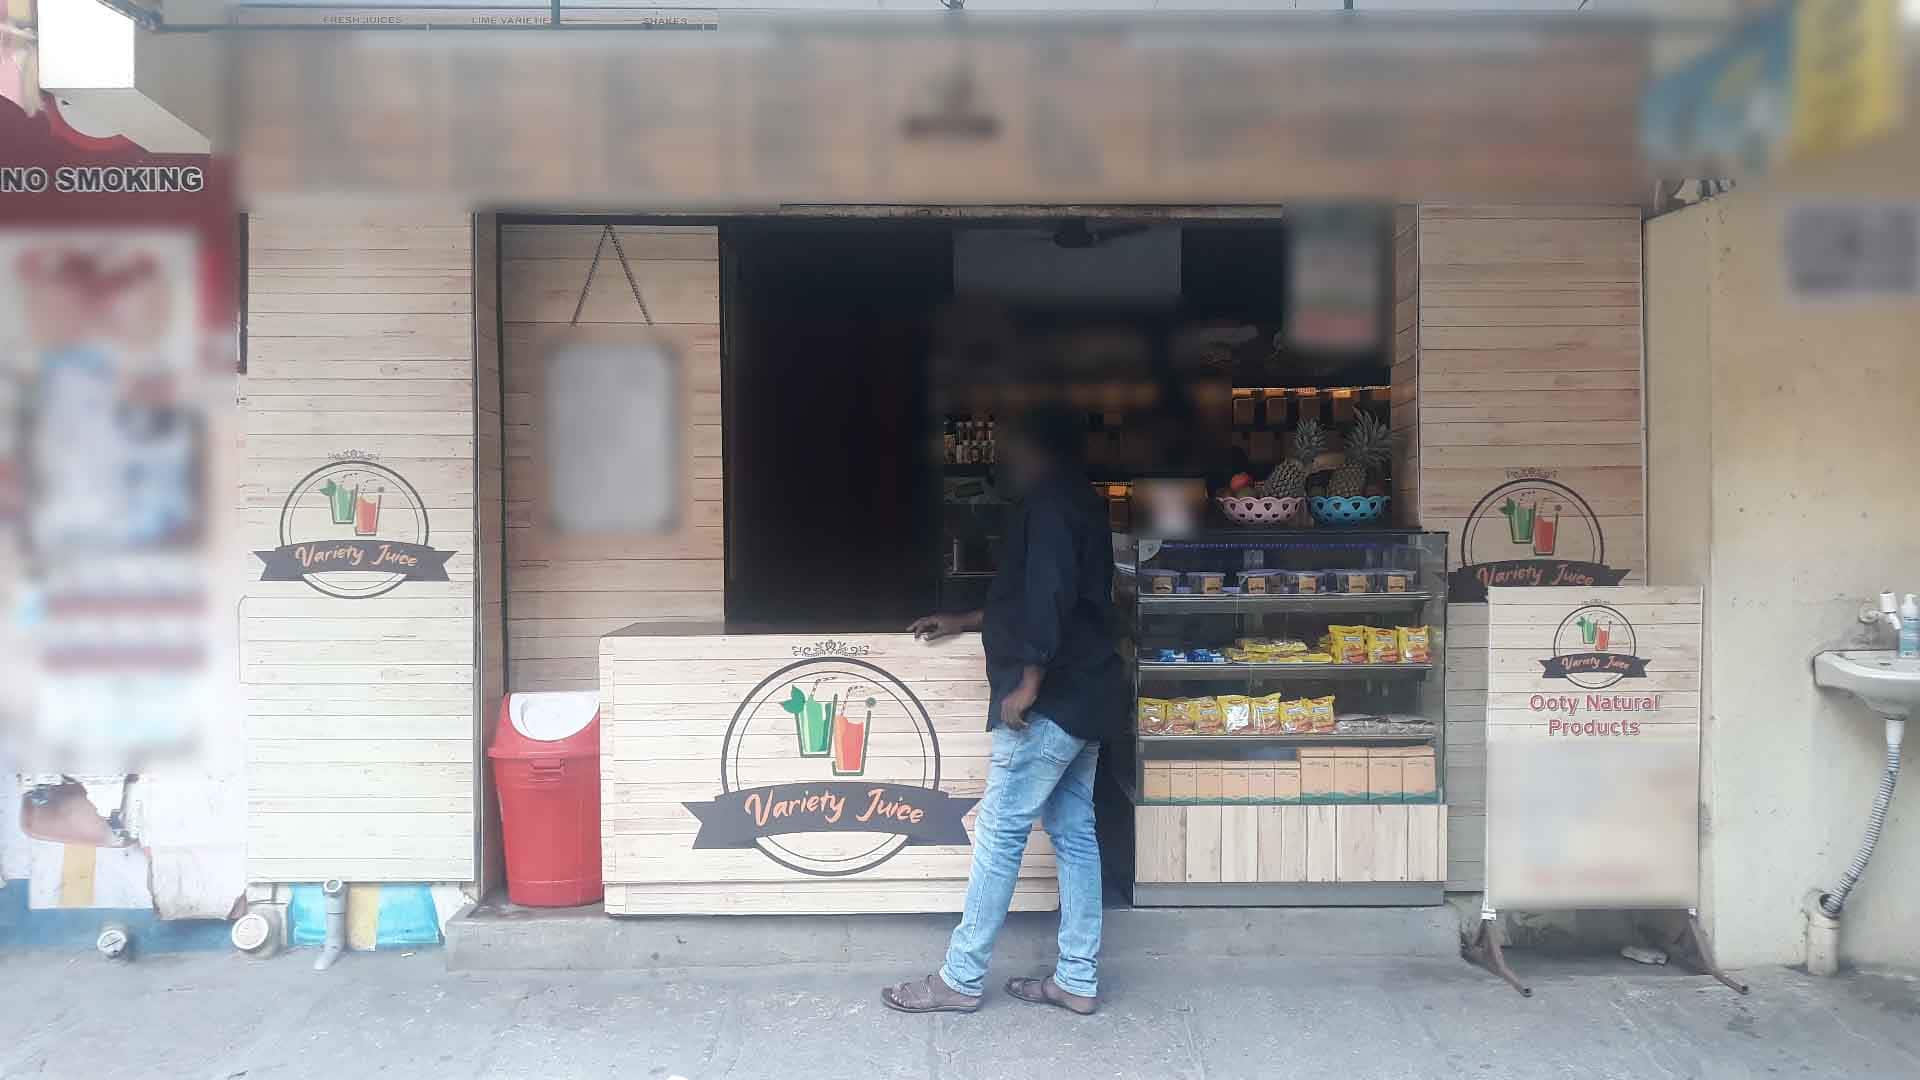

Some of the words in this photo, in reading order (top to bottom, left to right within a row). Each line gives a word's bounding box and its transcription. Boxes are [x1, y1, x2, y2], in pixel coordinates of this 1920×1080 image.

[0, 167, 48, 192] NO
[56, 167, 204, 192] SMOKING
[295, 545, 365, 568] Variety
[371, 544, 418, 567] Juice
[1477, 565, 1543, 586] Variety
[1550, 563, 1594, 586] Juice
[1530, 694, 1580, 716] Ooty
[1586, 694, 1661, 712] Natural
[1548, 719, 1641, 737] Products
[744, 789, 846, 828] Variety
[856, 788, 925, 825] Juice
